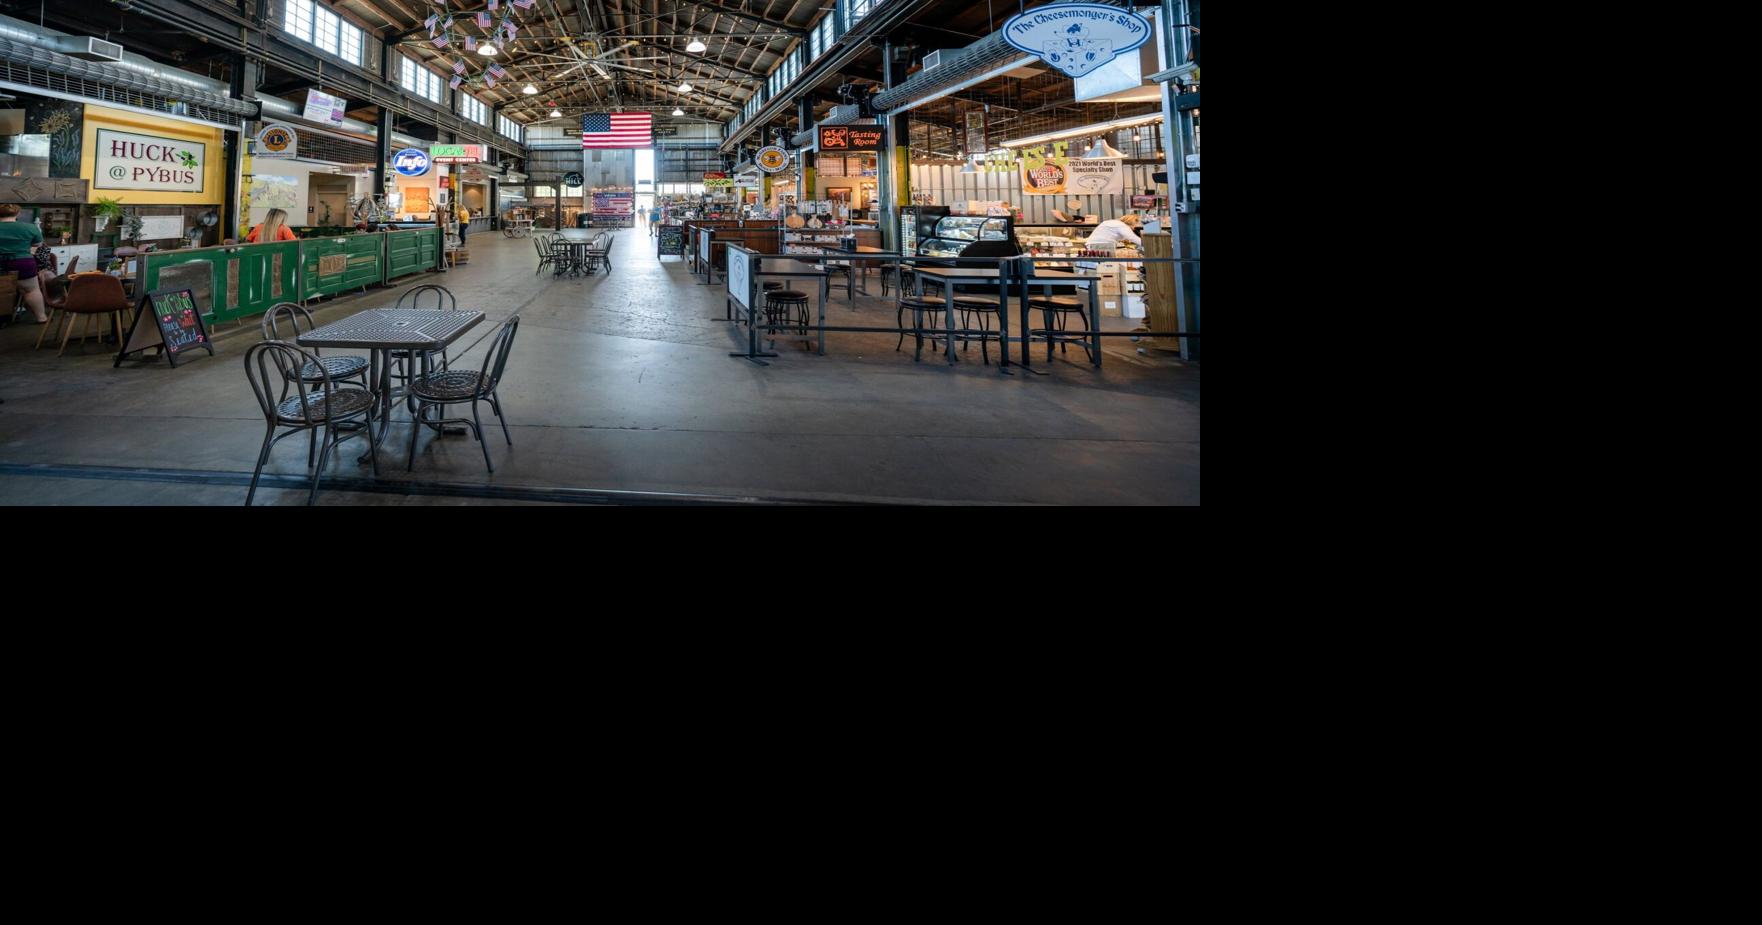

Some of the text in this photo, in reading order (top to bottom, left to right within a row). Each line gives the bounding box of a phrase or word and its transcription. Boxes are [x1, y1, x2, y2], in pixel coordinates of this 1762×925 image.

[1013, 9, 1142, 34] The Cheesemonger's Shop
[849, 131, 881, 140] Tasting
[111, 140, 177, 163] HUCK
[396, 155, 427, 170] Info
[109, 165, 194, 184] @ PYBUS
[1030, 168, 1064, 179] WORLD'S
[1037, 178, 1059, 188] BEST
